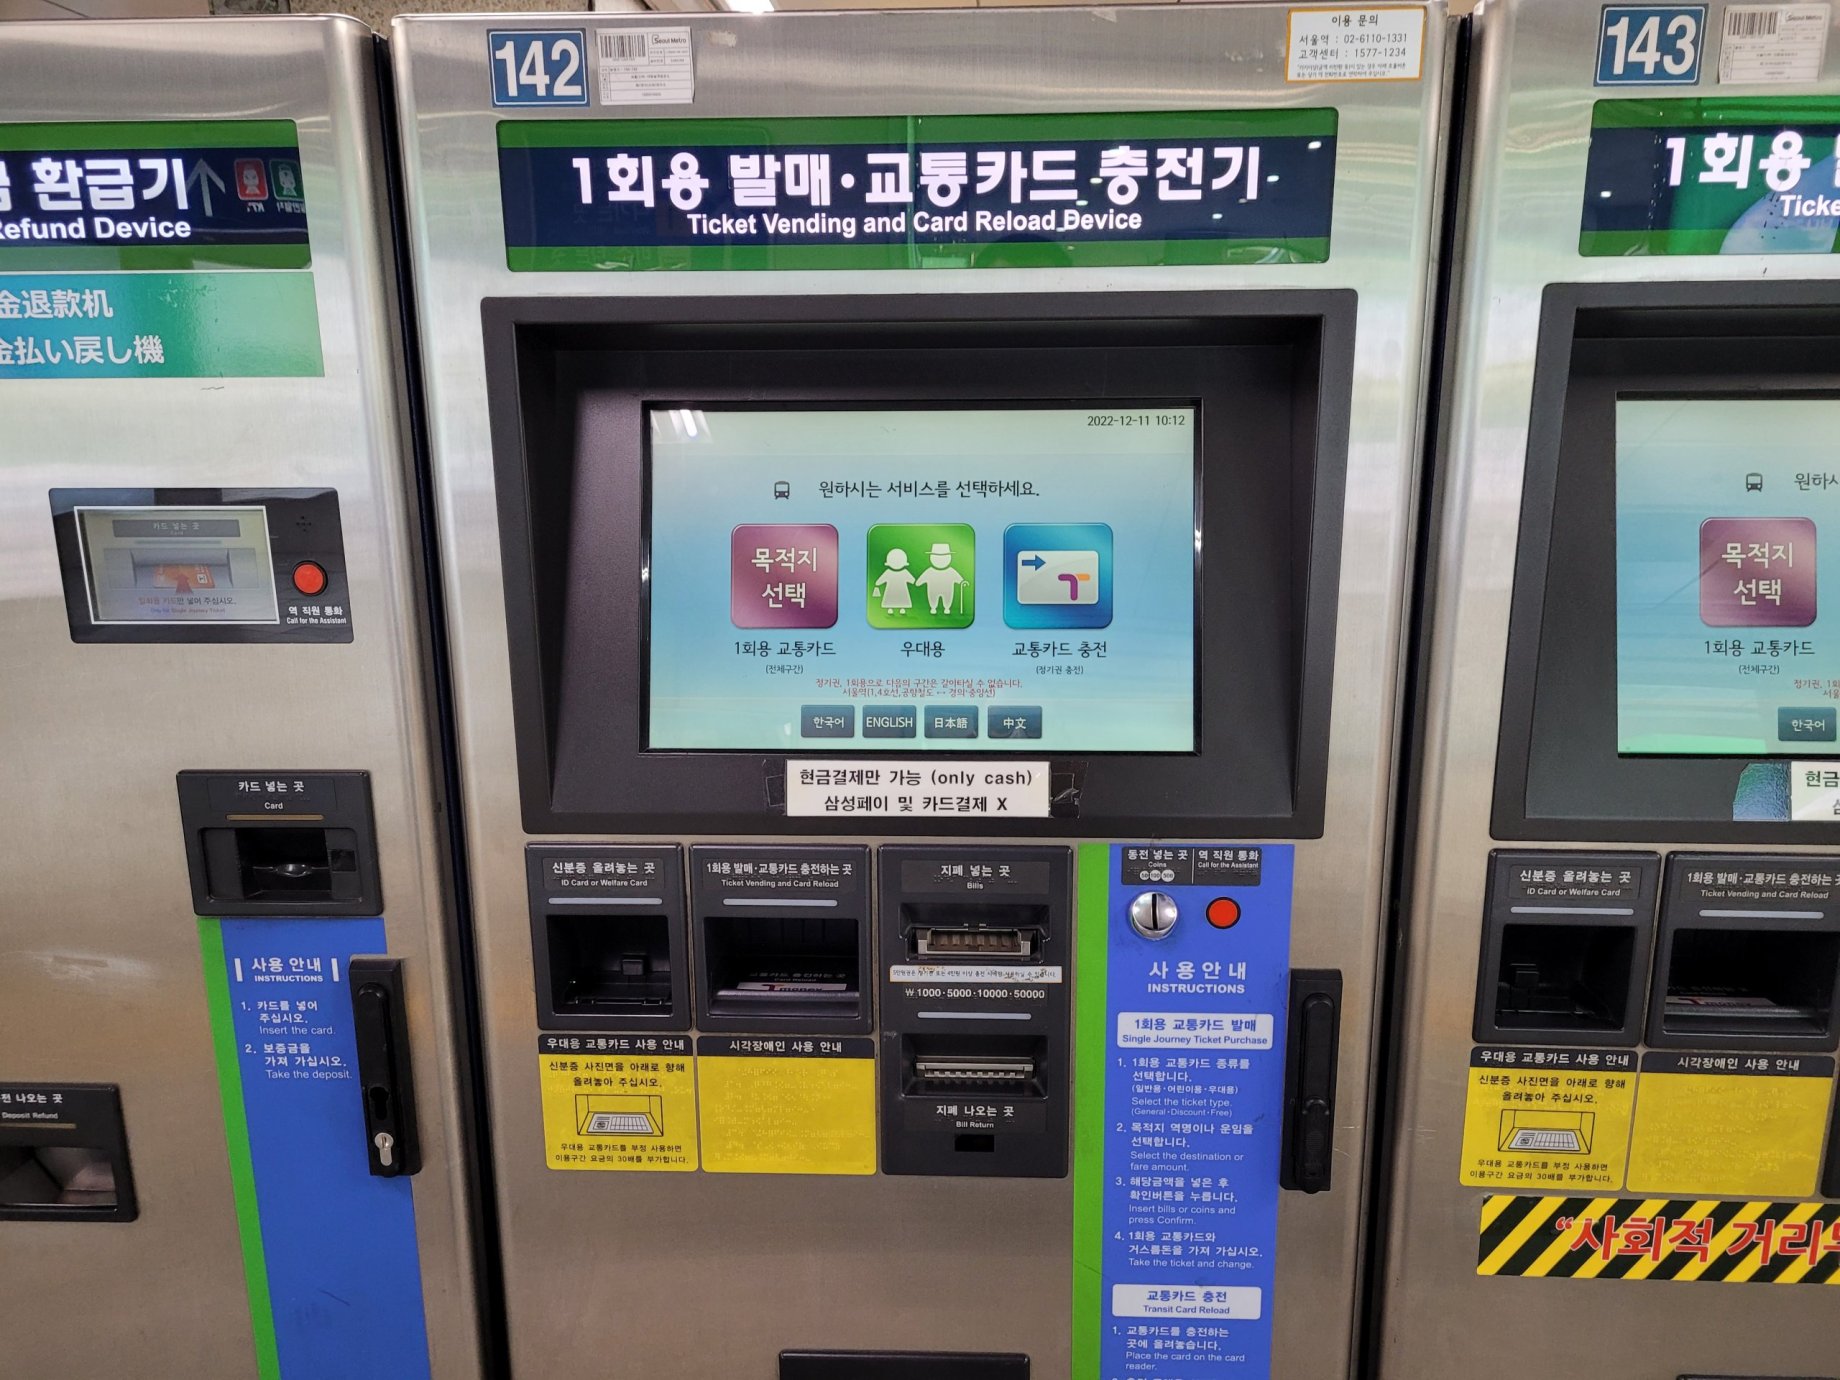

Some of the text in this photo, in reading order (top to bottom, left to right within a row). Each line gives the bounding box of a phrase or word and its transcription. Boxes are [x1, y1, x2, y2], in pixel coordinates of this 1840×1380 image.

[1332, 14, 1378, 27] 이용 문의
[1299, 34, 1407, 46] 서울역 02-6110-1331
[1607, 15, 1697, 75] 143
[1299, 48, 1406, 60] 고객센터 1577-1234
[494, 38, 582, 97] 142
[1666, 131, 1811, 191] 1회용
[572, 145, 1260, 211] 1회용 발매·교통카드 충전기
[31, 158, 188, 211] 환급기
[95, 217, 191, 239] Device
[687, 209, 1142, 238] Ticket Vending and Card Reload Device
[1087, 415, 1185, 426] 2022-12-11 10:12
[819, 480, 1040, 498] 원하시는 서비스를 선택하세요.
[751, 547, 818, 573] 목적지
[1722, 543, 1793, 568] 목적지
[762, 582, 807, 609] 선택
[1734, 579, 1782, 605] 선택
[289, 606, 343, 615] 역 직원 통화
[735, 641, 836, 657] 1회용 교통카드
[901, 641, 945, 657] 우대용
[1012, 641, 1107, 658] 교통카드 충전
[1705, 640, 1815, 656] 1회용 교통카드
[765, 664, 803, 675] (전체구간)
[1739, 665, 1779, 675] (전체구간)
[813, 717, 845, 729] 한국어
[866, 717, 913, 729] ENGLISH
[934, 717, 968, 729] 日本語
[1004, 718, 1026, 729] 中文
[1792, 720, 1826, 732] 한국어
[800, 770, 1032, 786] 현금결제만 가능 (only cash)
[238, 781, 304, 792] 카드 넣는 곳
[825, 796, 1007, 812] 삼성페이 및 카드결제 X
[1128, 850, 1173, 860] 동전 넣는
[1213, 851, 1259, 860] 직원 통화
[552, 862, 638, 874] 신분증 올려놓는
[707, 863, 731, 874] 1회용
[941, 865, 992, 876] 지폐 넣는
[1520, 870, 1612, 882] 신분증 올려놓는
[745, 880, 775, 888] Vending
[1728, 890, 1759, 898] Vending
[252, 958, 321, 972] 사용 안내
[1148, 984, 1245, 993] INSTRUCTIONS
[257, 1001, 289, 1011] 카드를
[260, 1013, 308, 1023] 주십시오.
[260, 1026, 336, 1034] Insert card.
[1135, 1018, 1256, 1032] 1회용 교통카드 발매
[547, 1038, 684, 1050] 우대용 교통카드 사용 안내
[1123, 1035, 1267, 1045] Single Journey Ticket Purchase
[264, 1044, 310, 1054] 보증금을
[729, 1040, 842, 1053] 시각장애인 사용 안내
[295, 1056, 346, 1067] 가십시오.
[1166, 1058, 1210, 1069] 교통카드
[1481, 1051, 1629, 1066] 우대용 교통카드 사용 안내
[1678, 1057, 1800, 1071] 시각장애인 사용 안내
[550, 1062, 659, 1072] 신분증 사진면을 아래로
[265, 1070, 352, 1080] Take deposit.
[1132, 1072, 1192, 1082] 선택합니다.
[619, 1077, 662, 1087] 주십시오.
[1566, 1078, 1597, 1088] 아래로
[16, 1094, 47, 1103] 나오는
[1132, 1098, 1207, 1107] Select ticket
[1552, 1093, 1597, 1104] 주십시오.
[936, 1105, 997, 1117] 지폐 나오는
[1131, 1123, 1214, 1134] 목적지 역명이나
[1131, 1137, 1190, 1148] 선택합니다.
[1131, 1152, 1232, 1161] Select destination
[1152, 1163, 1189, 1171] amount.
[1130, 1177, 1184, 1187] 해당금액을
[1129, 1205, 1215, 1214] Insert coins
[1157, 1216, 1196, 1225] Confirm.
[1161, 1232, 1216, 1242] 교통카드와
[1216, 1246, 1263, 1257] 가십시오.
[1129, 1258, 1254, 1270] Take ticket change.
[1147, 1290, 1227, 1303] 교통카드 충전
[1144, 1305, 1230, 1314] Transit Card Reload
[1127, 1326, 1180, 1337] 교통카드를
